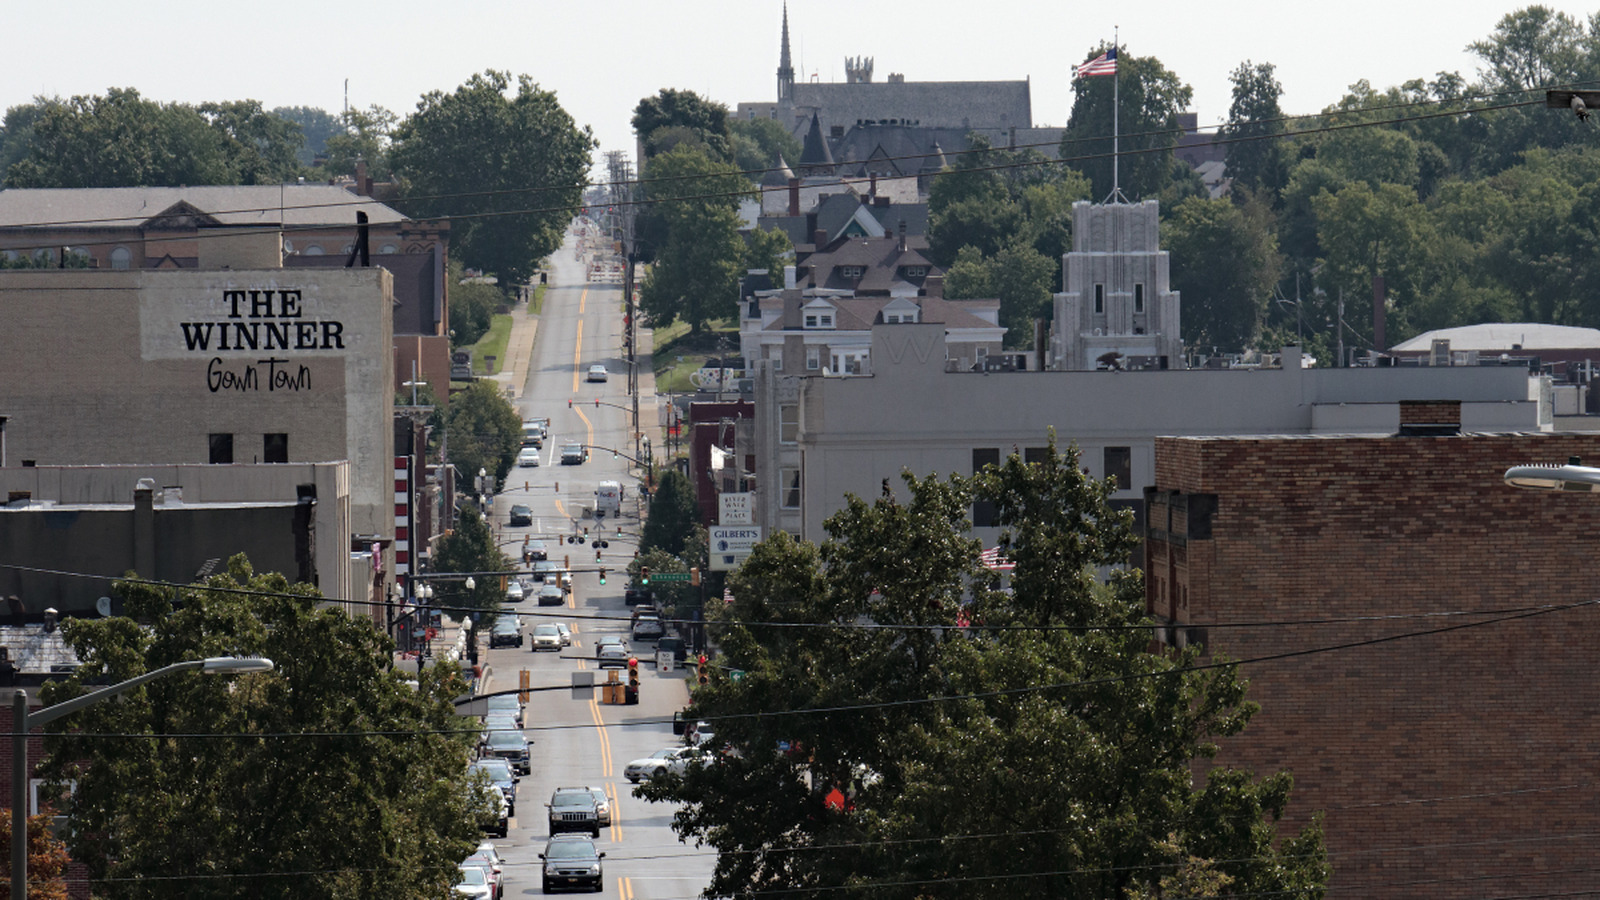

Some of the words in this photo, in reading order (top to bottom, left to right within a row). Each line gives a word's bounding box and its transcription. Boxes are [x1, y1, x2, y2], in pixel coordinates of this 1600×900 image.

[224, 290, 302, 318] THE
[180, 321, 345, 351] WINNER
[207, 357, 259, 393] Gown
[257, 356, 312, 392] Town
[714, 530, 758, 538] GILBERT'S
